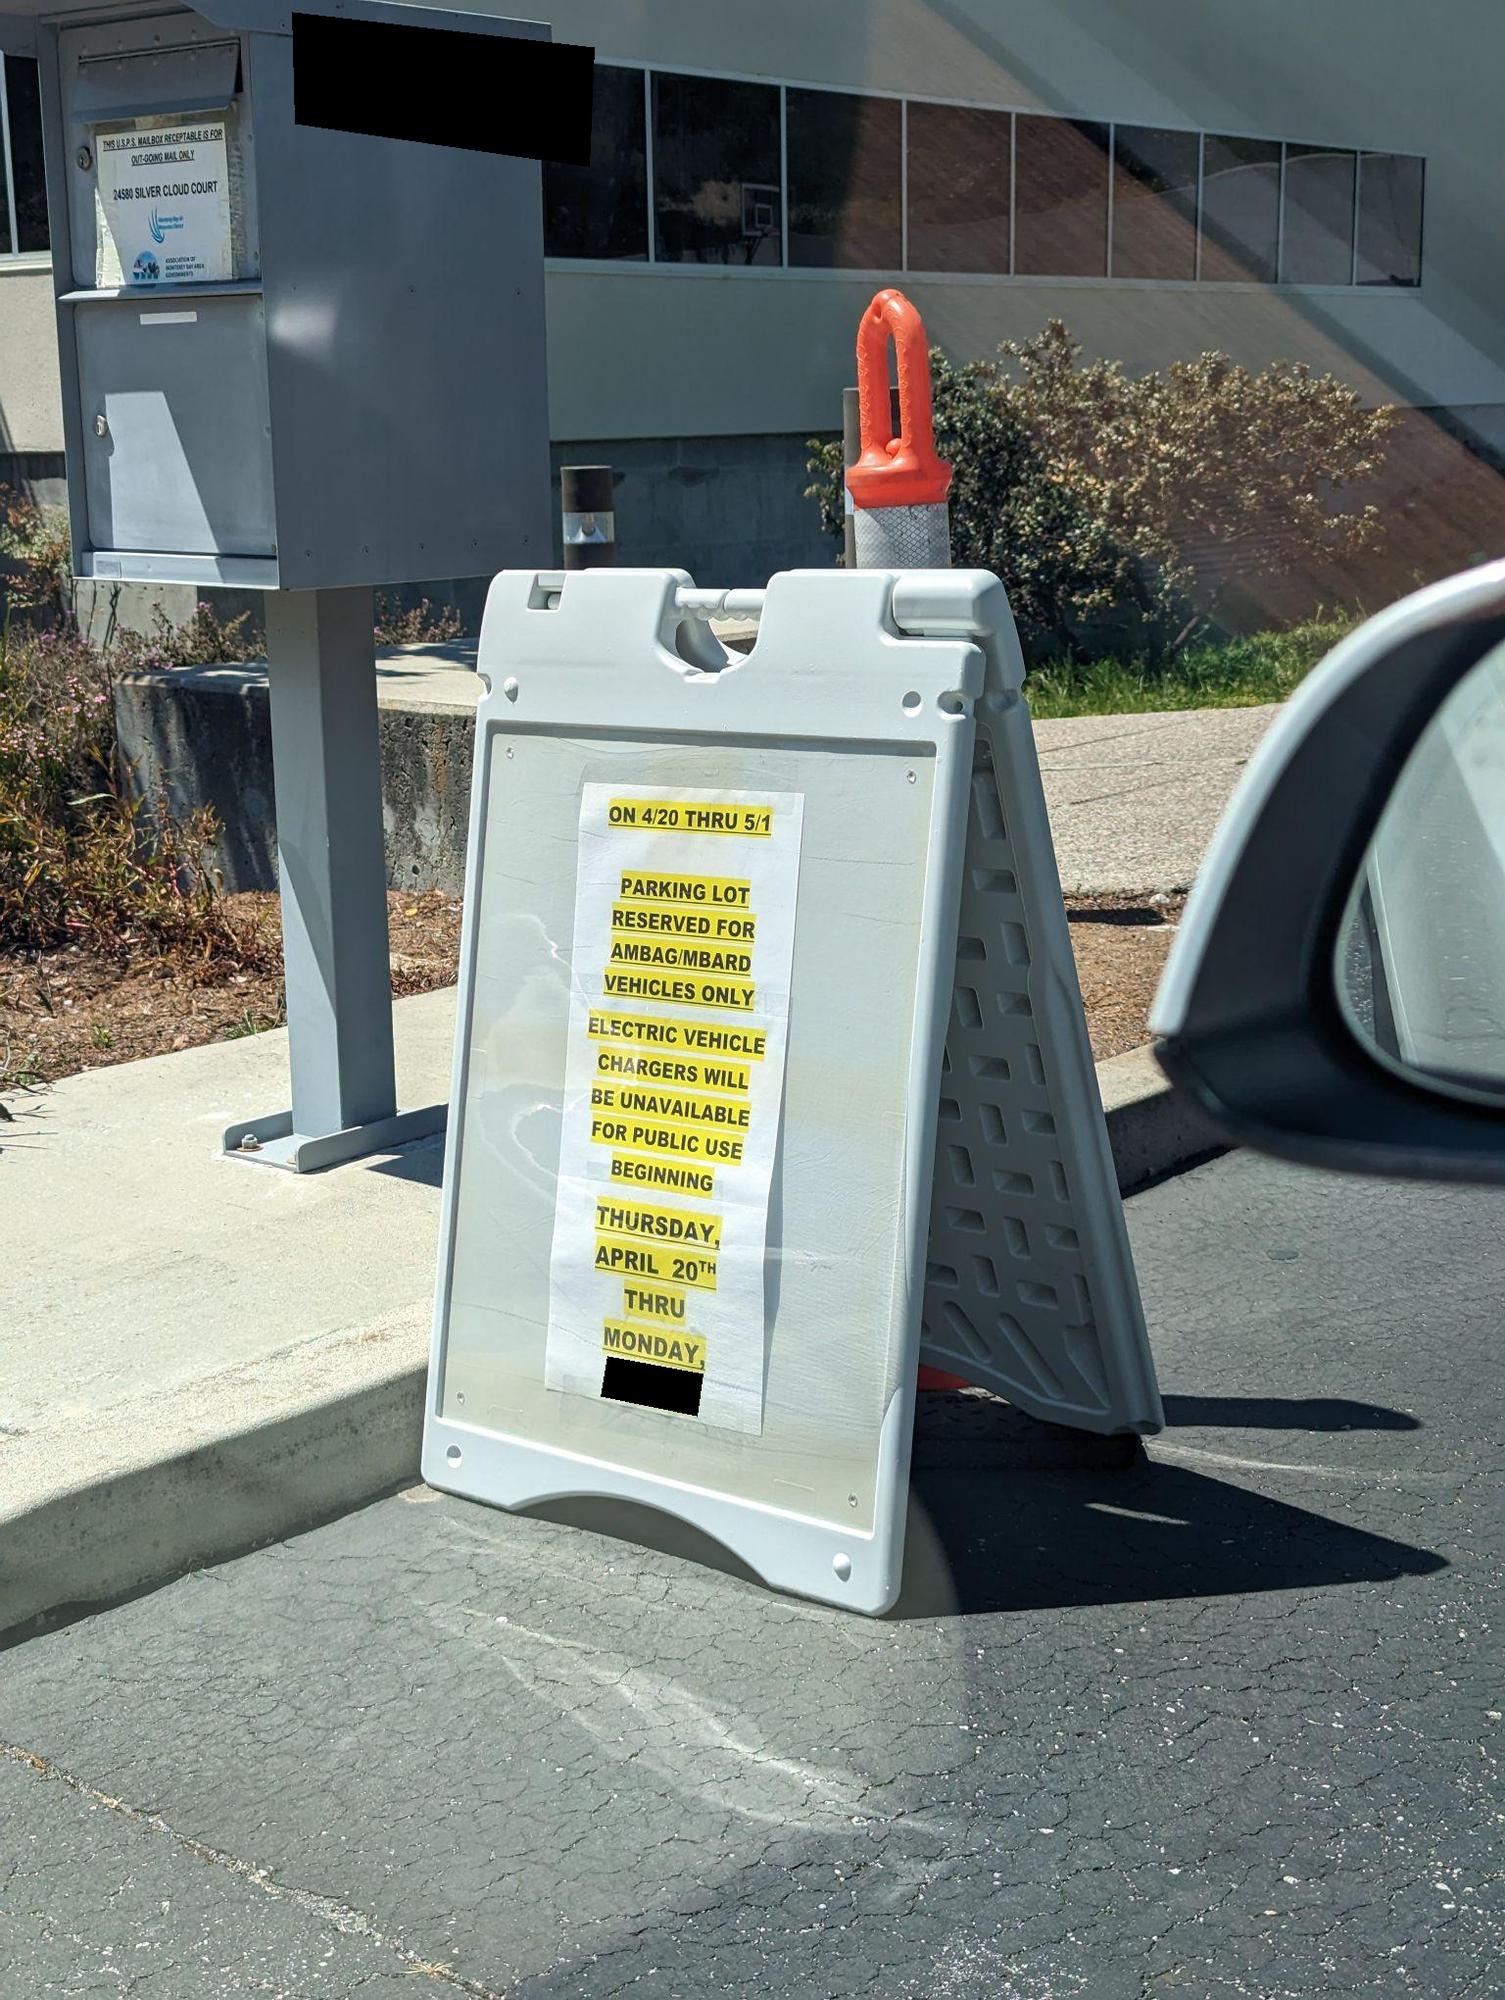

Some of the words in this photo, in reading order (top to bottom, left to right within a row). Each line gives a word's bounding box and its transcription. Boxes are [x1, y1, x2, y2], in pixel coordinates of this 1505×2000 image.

[103, 140, 115, 150] THIS
[138, 134, 163, 146] MAILBOX
[164, 130, 202, 143] RECEPTABLE
[203, 130, 208, 140] IS
[210, 128, 223, 138] FOR
[131, 152, 162, 164] OUT-GOING
[164, 151, 177, 162] MAIL
[179, 150, 194, 160] ONLY
[113, 188, 134, 200] 24580
[134, 185, 161, 199] SILVER
[163, 183, 189, 196] CLOUD
[191, 181, 218, 194] COURT
[608, 805, 636, 824] ON
[642, 808, 678, 826] 4/20
[685, 810, 737, 830] THRU
[744, 814, 770, 832] 5/1
[620, 878, 706, 901] PARKING
[712, 884, 750, 904] LOT
[612, 910, 710, 936] RESERVED
[716, 919, 755, 939] FOR
[611, 942, 751, 973] AMBAG/MBARD
[604, 974, 696, 1000] VEHICLES
[702, 985, 754, 1006] ONLY
[588, 1016, 678, 1044] ELECTRIC
[684, 1028, 766, 1055] VEHICLE
[598, 1054, 698, 1082] CHARGERS
[704, 1068, 749, 1090] WILL
[591, 1087, 614, 1106] BE
[620, 1091, 750, 1127] UNAVAILABLE
[592, 1120, 626, 1142] FOR
[632, 1128, 699, 1153] PUBLIC
[706, 1138, 743, 1160] USE
[611, 1160, 713, 1192] BEGINNING
[597, 1206, 720, 1249] THURSDAY,
[595, 1246, 658, 1274] APRIL
[672, 1258, 716, 1281] 20TH
[624, 1289, 685, 1318] THRU
[604, 1326, 705, 1370] MONDAY,
